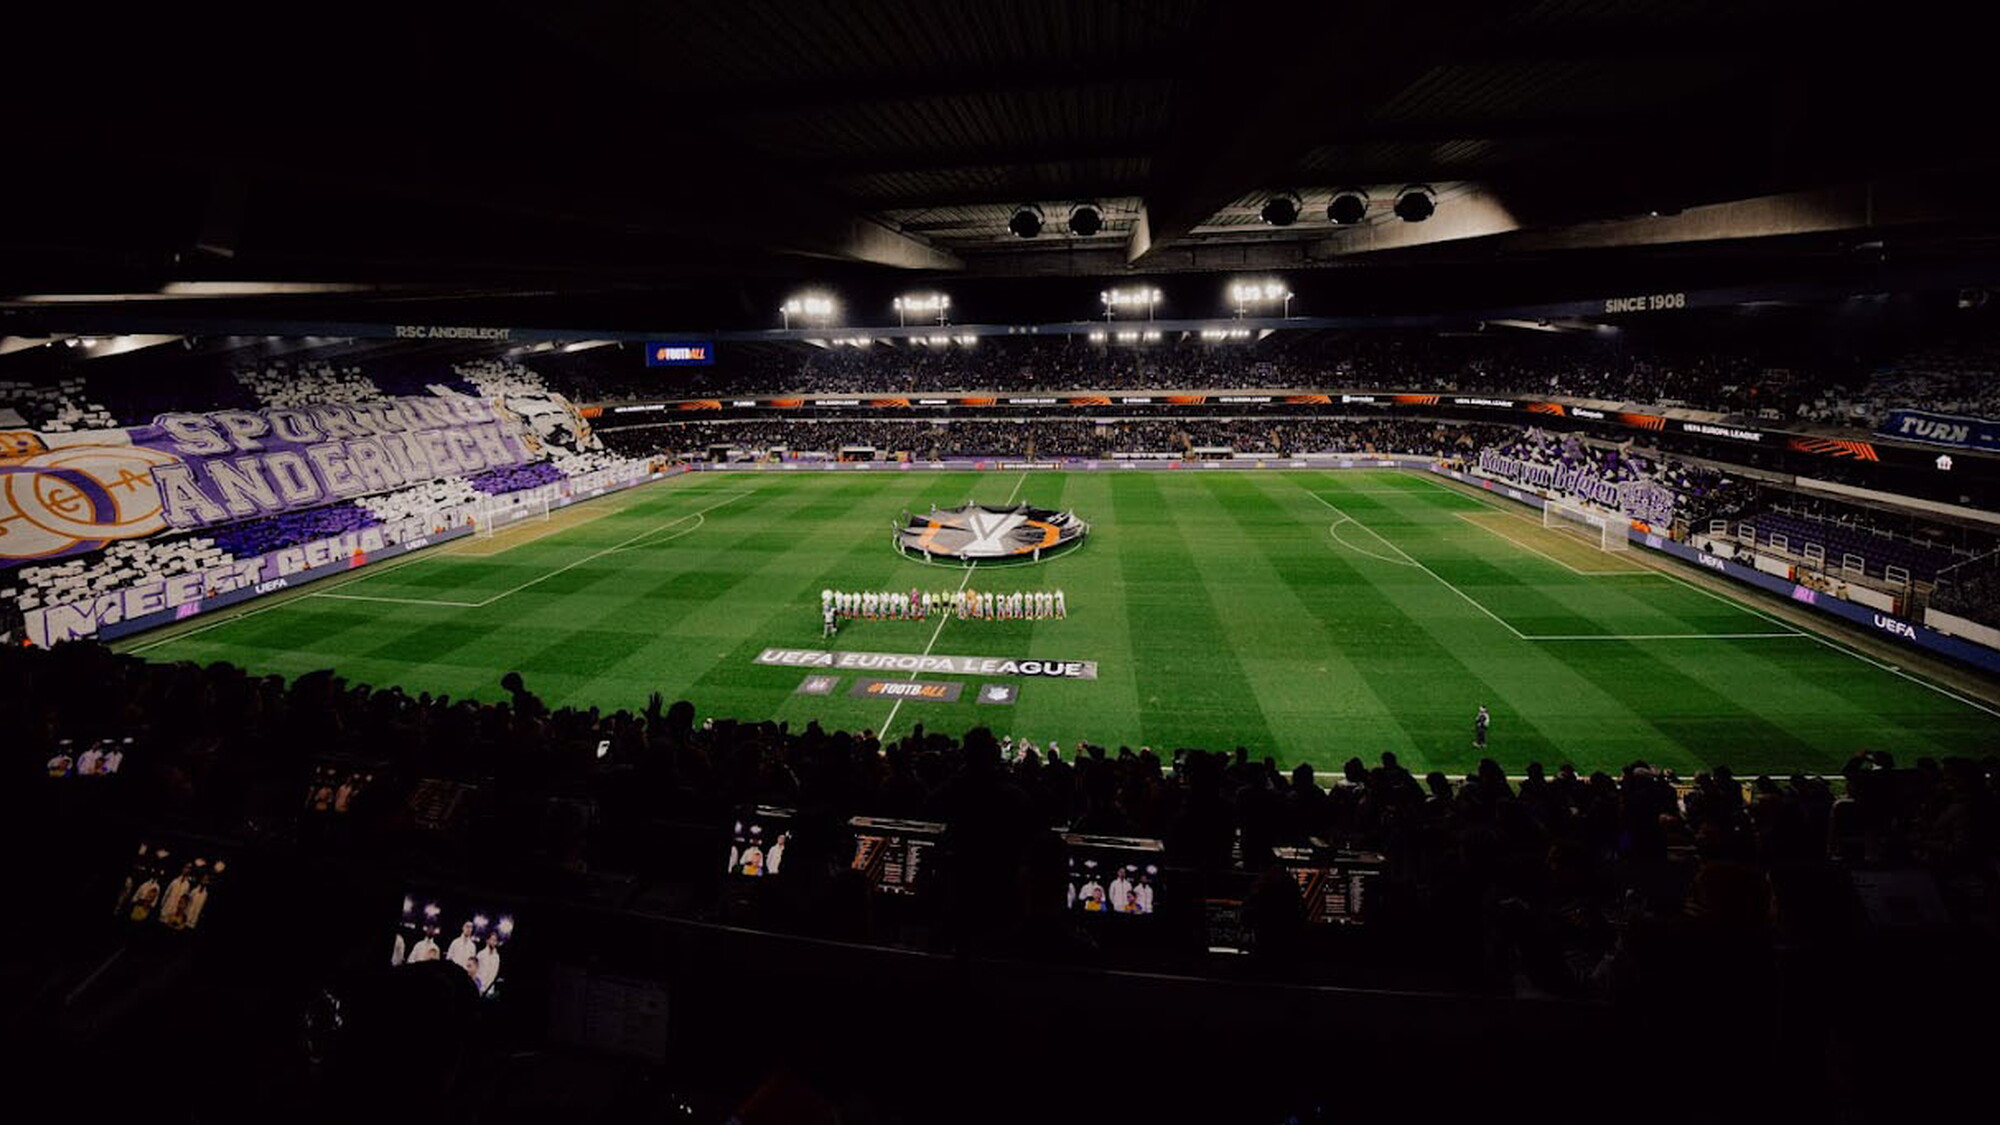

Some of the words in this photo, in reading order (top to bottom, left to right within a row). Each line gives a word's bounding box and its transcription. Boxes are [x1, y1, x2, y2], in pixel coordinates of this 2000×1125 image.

[1605, 297, 1646, 313] SINCE
[1649, 293, 1685, 310] 1908
[396, 326, 426, 338] RSC
[428, 327, 510, 340] ANDERLECHT
[656, 347, 706, 361] #FOOTBALL
[1683, 423, 1700, 433] UEFA
[1701, 425, 1730, 437] EUROPA
[1730, 429, 1763, 441] LEAGUE
[1900, 416, 1970, 442] TURN
[1698, 552, 1725, 571] UEFA
[255, 577, 287, 594] UEFA
[1874, 613, 1917, 641] UEFA
[761, 650, 834, 666] UEFA
[840, 653, 955, 673] EUROPA
[962, 659, 1084, 677] LEAGUE
[867, 682, 947, 698] #FOOTBALL
